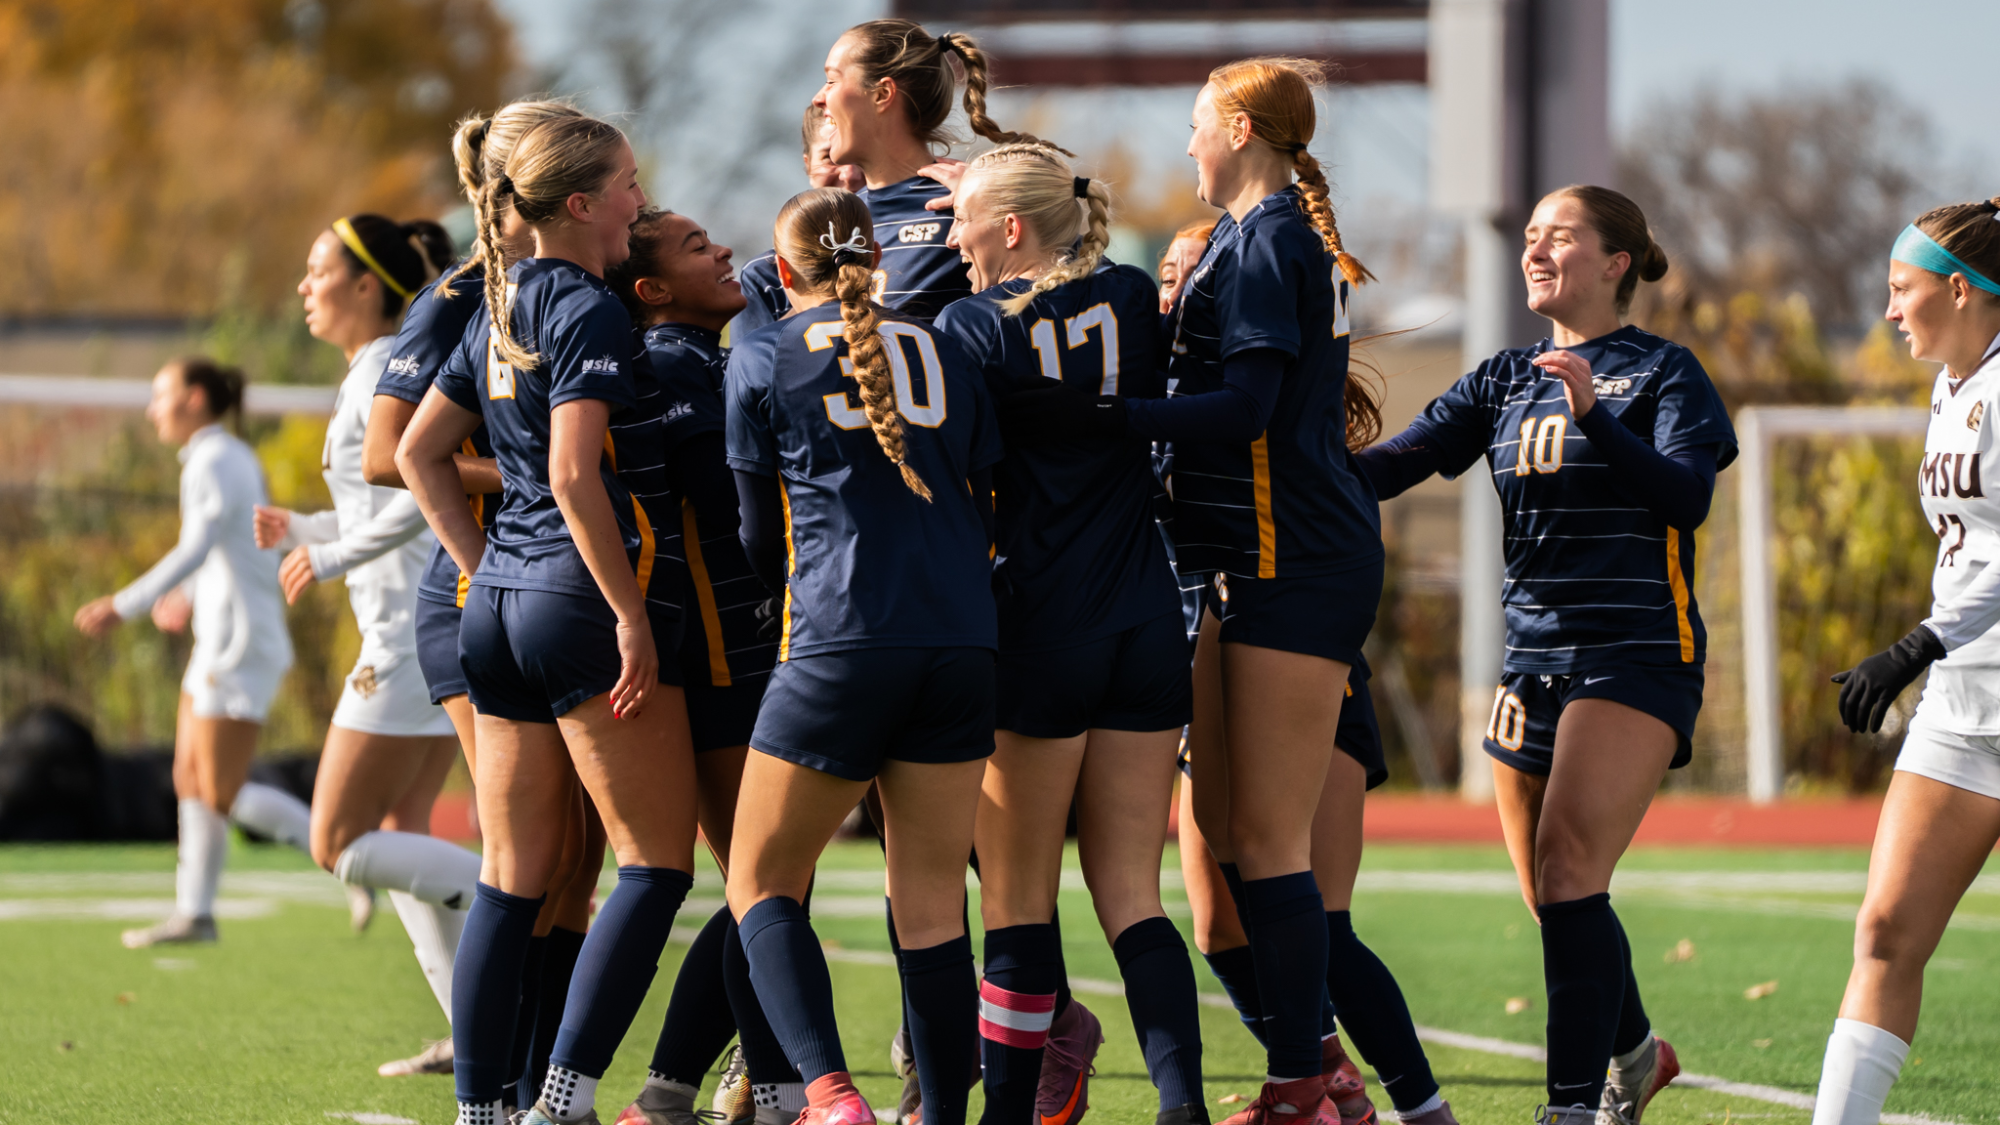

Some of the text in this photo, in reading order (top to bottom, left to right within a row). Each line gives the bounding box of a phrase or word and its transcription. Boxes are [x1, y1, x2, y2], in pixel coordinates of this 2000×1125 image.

[898, 223, 941, 243] CSP
[803, 319, 947, 431] 30
[1030, 301, 1119, 396] 17
[1515, 413, 1567, 477] 10
[1918, 451, 1987, 500] MSU
[1486, 684, 1526, 752] 10
